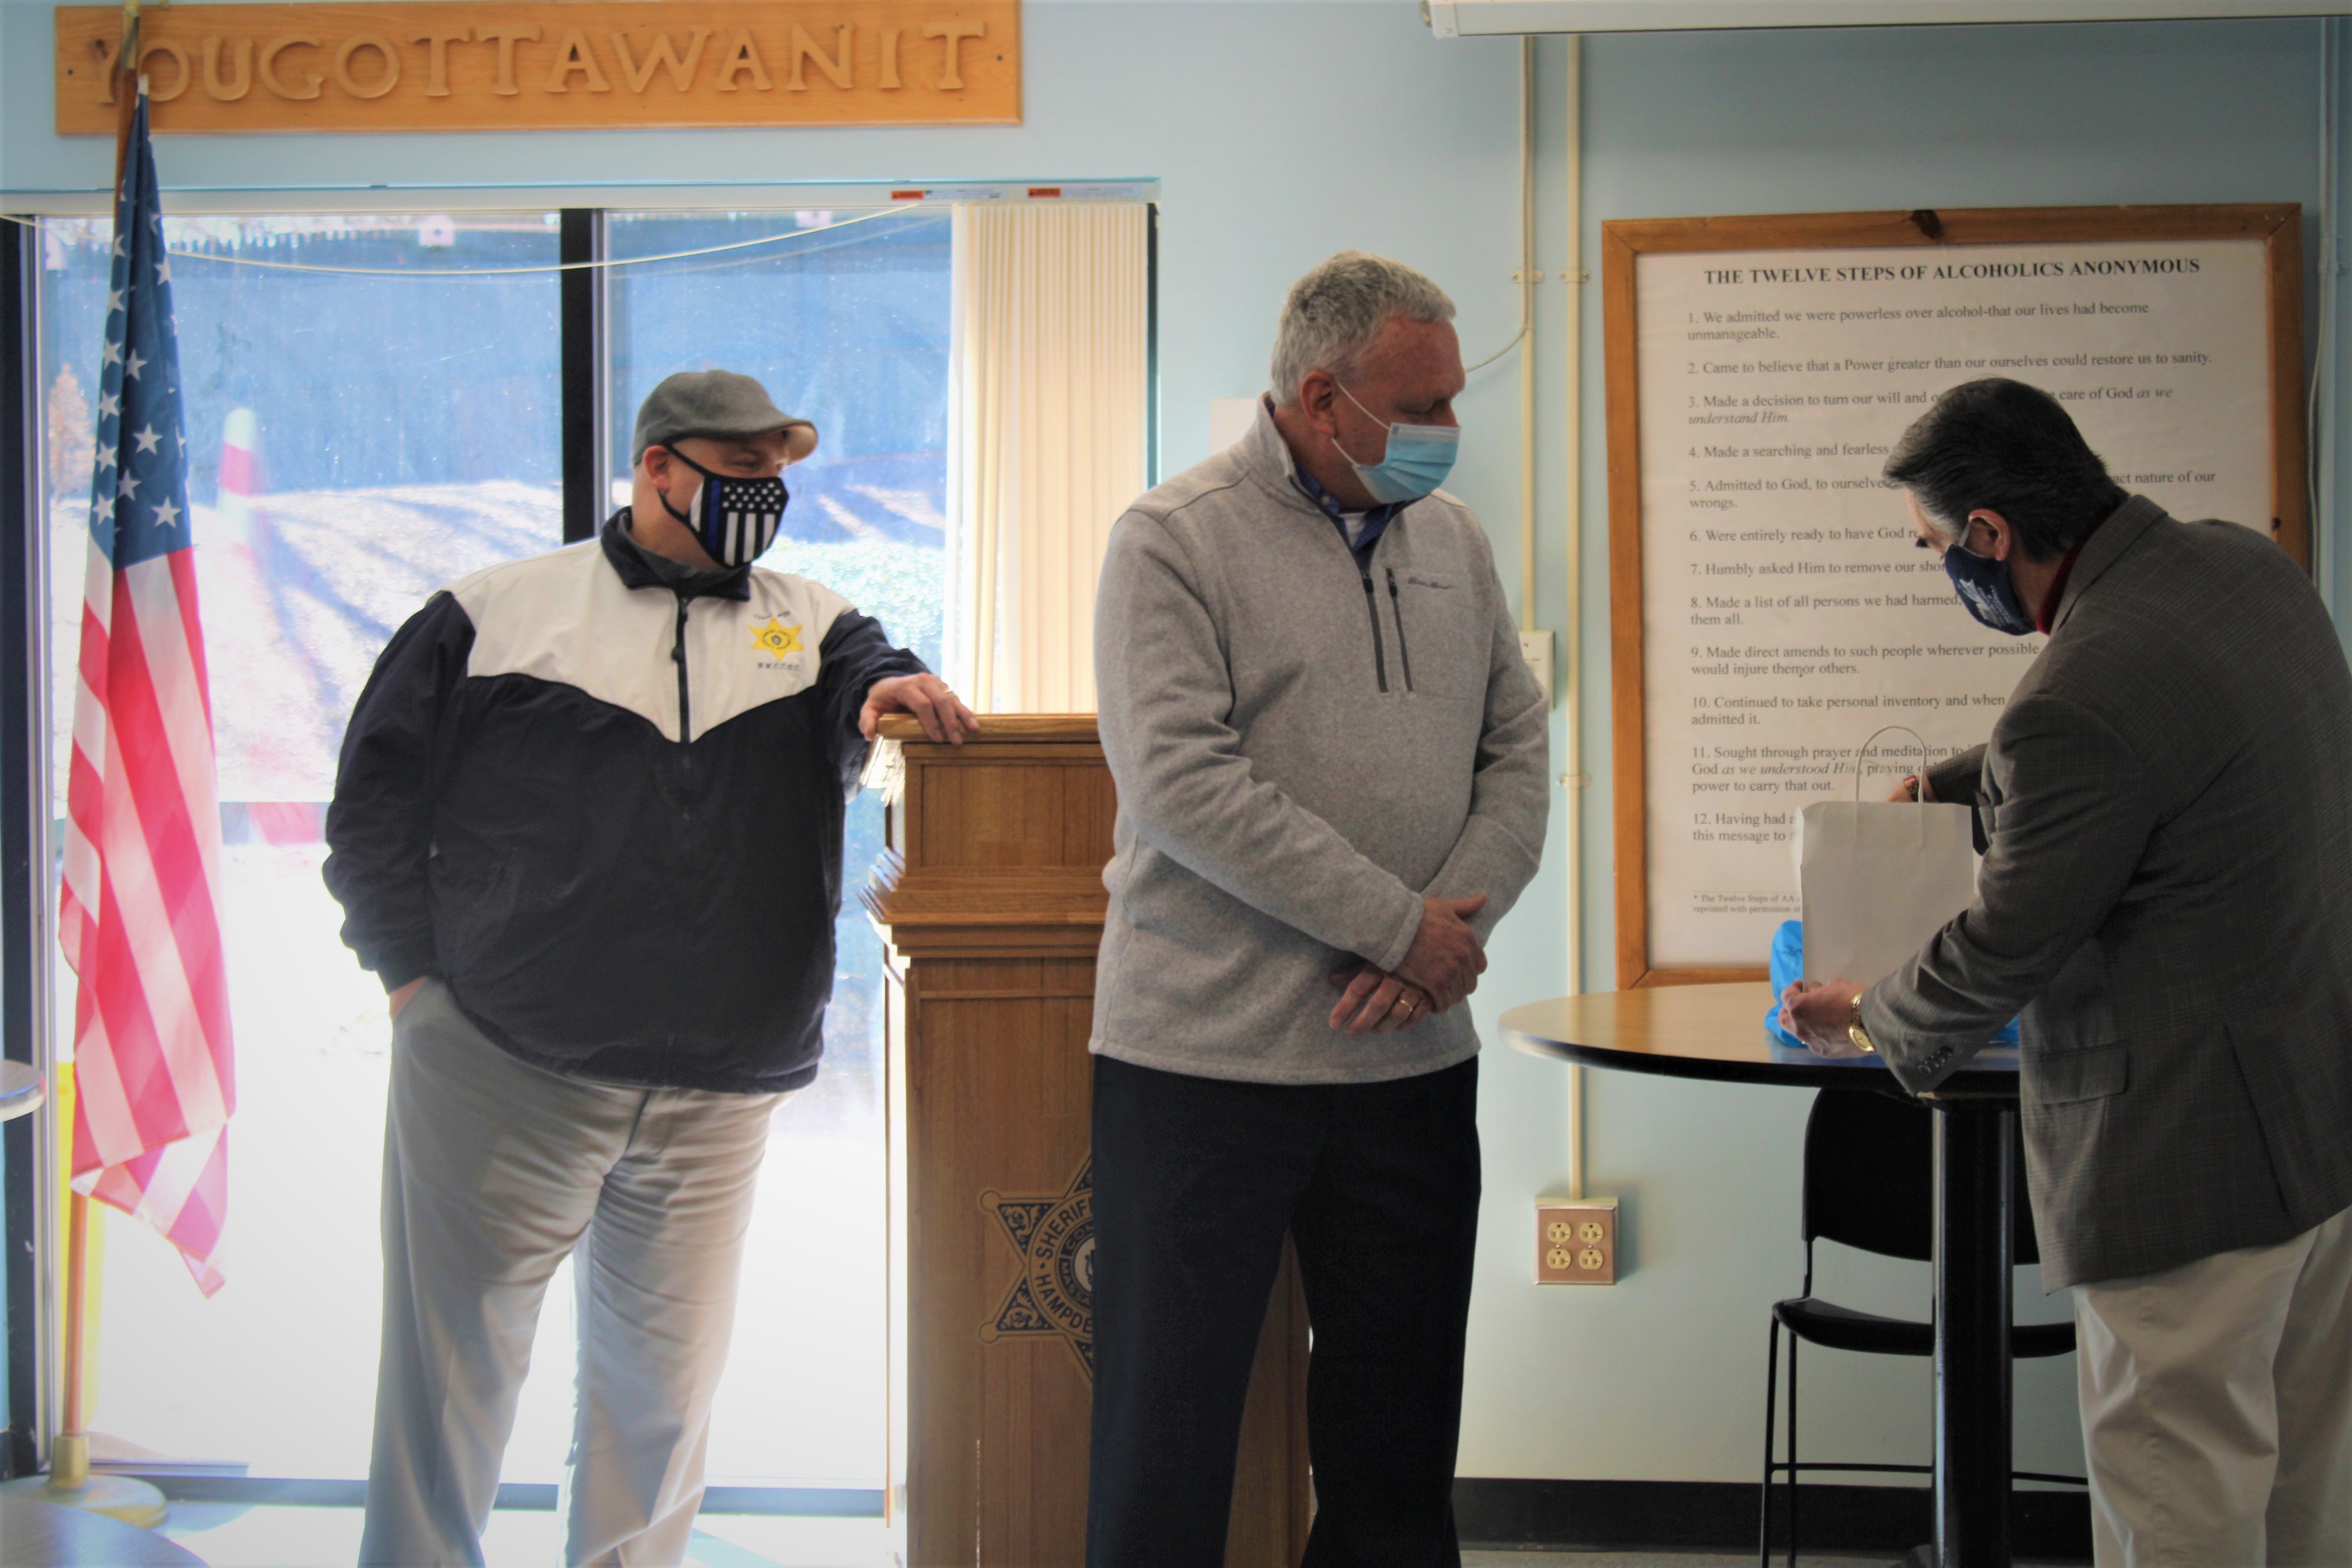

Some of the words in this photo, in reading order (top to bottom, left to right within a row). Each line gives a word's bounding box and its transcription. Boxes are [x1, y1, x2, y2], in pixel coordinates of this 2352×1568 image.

[1704, 269, 1743, 285] THE
[1749, 267, 1831, 283] TWELVE
[1837, 266, 1895, 281] STEPS
[1900, 266, 1927, 280] OF
[1933, 262, 2064, 279] ALCOHOLICS
[2070, 259, 2200, 276] ANONYMOUS
[1689, 313, 1698, 324] 1.
[1703, 312, 1723, 324] We
[1726, 309, 1780, 323] admitted
[1784, 312, 1802, 322] we
[1806, 312, 1835, 321] were
[1840, 308, 1902, 324] powerless
[1905, 309, 1933, 319] over
[1937, 305, 2011, 318] alcohol-that
[2014, 307, 2036, 316] our
[2040, 303, 2069, 316] lives
[2073, 302, 2096, 315] had
[2100, 302, 2149, 315] become
[1687, 326, 1779, 343] unmanageable.
[1688, 362, 1698, 375] 2.
[1703, 362, 1739, 374] Came
[1742, 363, 1755, 373] to
[1758, 360, 1802, 373] believe
[1807, 359, 1830, 372] that
[1834, 362, 1841, 371] a
[1844, 358, 1884, 371] Power
[1887, 356, 1931, 373] greater
[1934, 357, 1961, 369] than
[1965, 359, 1986, 368] our
[1990, 355, 2049, 368] ourselves
[2052, 353, 2087, 367] could
[2091, 355, 2134, 366] restore
[2138, 355, 2152, 365] us
[2155, 354, 2168, 364] to
[2172, 351, 2211, 366] sanity.
[1689, 396, 1698, 408] 3.
[1704, 395, 1738, 407] Made
[1742, 398, 1749, 407] a
[1752, 394, 1804, 407] decision
[1808, 395, 1820, 406] to
[1824, 395, 1848, 406] turn
[1852, 395, 1873, 404] our
[1877, 391, 1900, 404] will
[1905, 391, 1926, 403] and
[2060, 390, 2085, 400] care
[2089, 387, 2104, 400] of
[2106, 387, 2133, 399] God
[2137, 390, 2151, 398] as
[2155, 389, 2173, 398] we
[1689, 411, 1759, 424] understand
[1761, 411, 1789, 423] Him.
[1688, 447, 1700, 458] 4.
[1704, 445, 1739, 458] Made
[1743, 448, 1750, 458] a
[1753, 444, 1812, 459] searching
[1816, 443, 1838, 456] and
[1843, 443, 1889, 456] fearless
[1690, 480, 1700, 492] 5.
[1705, 479, 1762, 492] Admitted
[1765, 481, 1778, 491] to
[1815, 479, 1828, 489] to
[1831, 476, 1889, 490] ourselve
[2113, 473, 2131, 484] act
[2135, 472, 2174, 484] nature
[2177, 470, 2193, 483] of
[2194, 473, 2216, 482] our
[1690, 499, 1737, 511] wrongs.
[1690, 531, 1700, 542] 6.
[1706, 530, 1737, 541] Were
[1740, 528, 1787, 544] entirely
[1791, 528, 1825, 543] ready
[1828, 530, 1841, 540] to
[1845, 527, 1874, 540] have
[1877, 527, 1905, 539] God
[1691, 563, 1701, 575] 7.
[1706, 563, 1755, 578] Humbly
[1759, 561, 1794, 574] asked
[1798, 561, 1825, 574] Him
[1828, 563, 1841, 574] to
[1845, 563, 1891, 573] remove
[1894, 563, 1916, 573] our
[1691, 597, 1701, 609] 8.
[1706, 596, 1740, 608] Made
[1744, 599, 1751, 608] a
[1755, 596, 1773, 608] list
[1777, 595, 1792, 607] of
[1794, 595, 1809, 607] all
[1813, 597, 1860, 610] persons
[1864, 597, 1881, 606] we
[1886, 594, 1907, 606] had
[1691, 613, 1721, 625] them
[1725, 612, 1743, 625] all.
[1691, 646, 1702, 658] 9.
[1707, 646, 1741, 658] Made
[1745, 645, 1779, 658] direct
[1783, 645, 1830, 658] amends
[1834, 647, 1846, 657] to
[1850, 645, 1878, 657] such
[1881, 644, 1923, 660] people
[1927, 644, 1985, 656] wherever
[1988, 642, 2039, 658] possible
[1691, 662, 1729, 675] would
[1733, 662, 1769, 678] injure
[1819, 662, 1860, 674] others.
[1693, 696, 1710, 708] 10.
[1714, 695, 1778, 708] Continued
[1781, 697, 1794, 708] to
[1797, 695, 1823, 708] take
[1827, 695, 1878, 711] personal
[1883, 695, 1941, 709] inventory
[1945, 694, 1968, 706] and
[1972, 694, 2004, 706] when
[1691, 713, 1745, 726] admitted
[1749, 713, 1760, 725] it.
[1694, 747, 1710, 759] 11.
[1714, 746, 1757, 761] Sought
[1760, 746, 1808, 762] through
[1812, 748, 1852, 761] prayer
[1881, 744, 1948, 757] meditaion
[1691, 763, 1718, 775] God
[1721, 767, 1735, 775] as
[1739, 766, 1756, 775] we
[1760, 762, 1830, 775] understood
[1692, 783, 1730, 795] power
[1734, 781, 1746, 791] to
[1749, 782, 1781, 795] carry
[1784, 779, 1808, 791] that
[1811, 781, 1834, 791] out.
[1694, 812, 1711, 825] 12.
[1716, 813, 1760, 828] Having
[1763, 812, 1786, 825] had
[1693, 829, 1714, 841] this
[1719, 832, 1770, 845] message
[1773, 831, 1786, 841] to
[1035, 1274, 1092, 1334] HAMPDE
